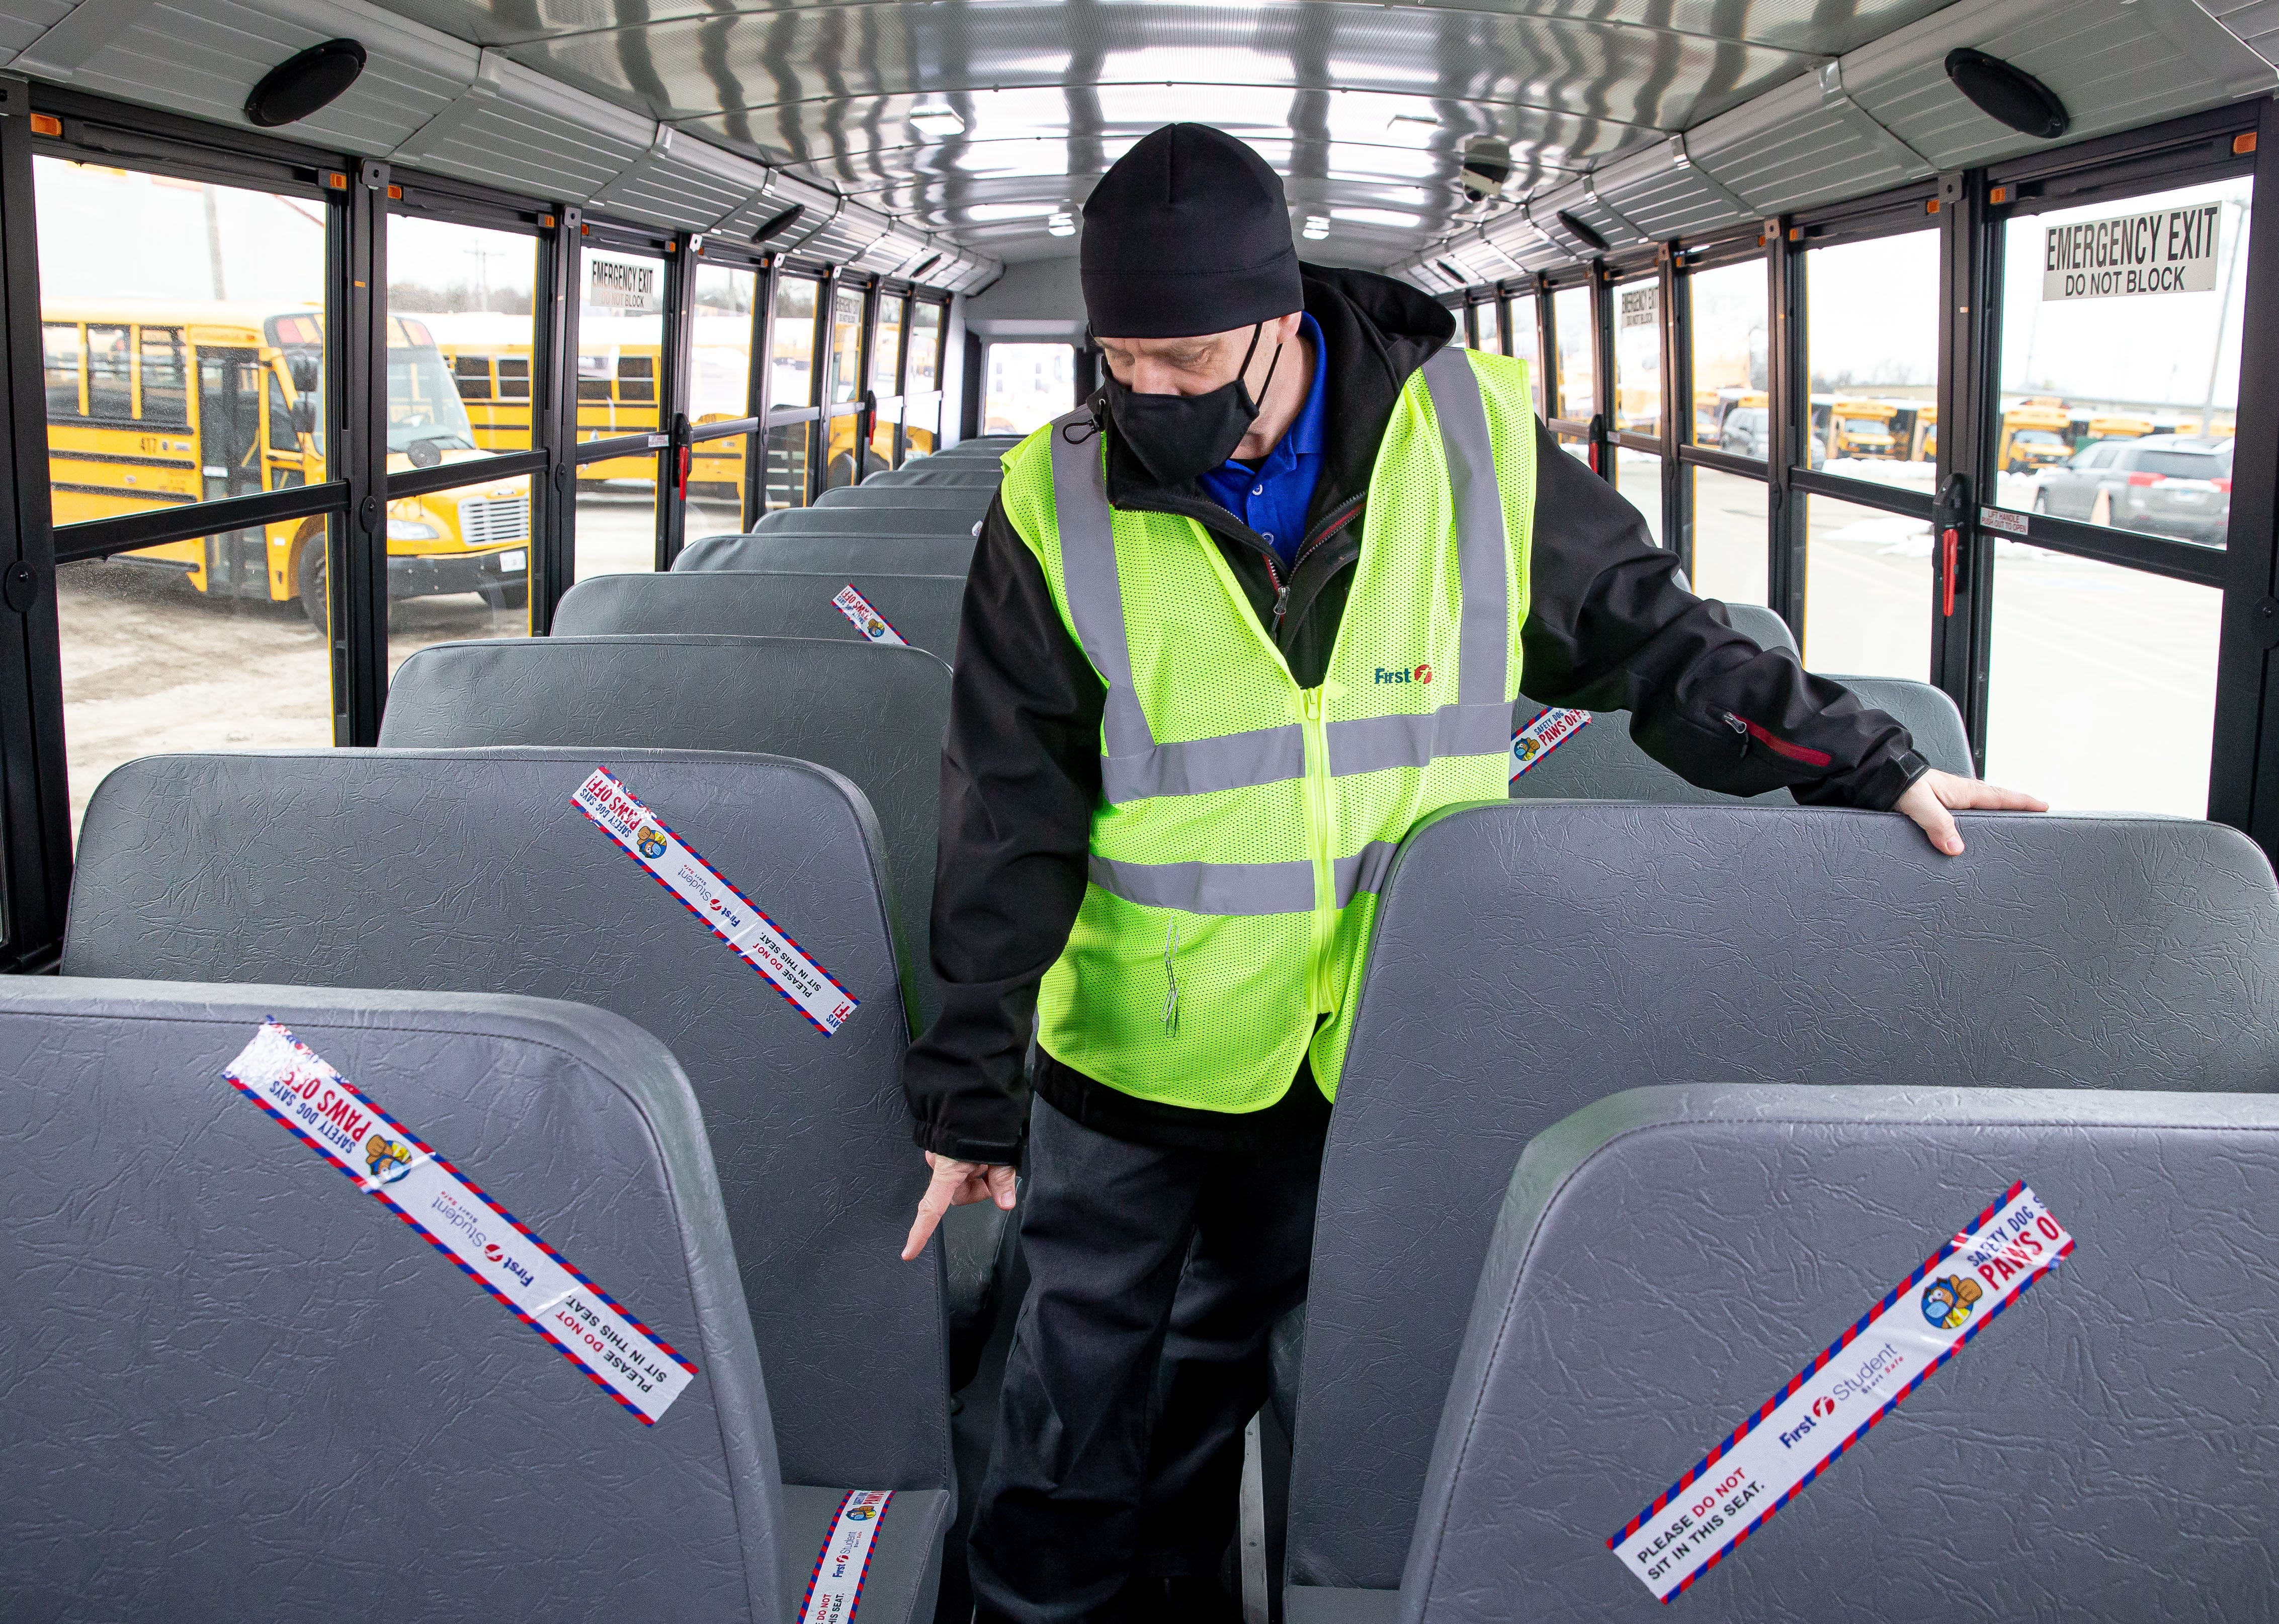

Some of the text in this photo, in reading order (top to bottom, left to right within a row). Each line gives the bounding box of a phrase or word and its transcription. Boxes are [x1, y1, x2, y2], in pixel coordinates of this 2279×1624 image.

[2047, 207, 2218, 271] EMERGENCY EXIT
[593, 261, 653, 293] EMERGENCY EXIT
[601, 291, 644, 308] DO NOT BLOCK
[2065, 266, 2186, 296] DO NOT BLOCK
[1999, 512, 2019, 523] HANDLE
[840, 588, 856, 604] OFF!
[1375, 668, 1411, 684] First
[1534, 710, 1564, 735] SAFETY DOG
[1538, 721, 1567, 747] PAWS
[580, 789, 632, 838] SAFETY DOG SAYS
[585, 776, 642, 831] PAWS OFF!
[678, 868, 741, 927] First Student
[753, 944, 813, 998] PLEASE DO NOT
[759, 932, 822, 992] SIT IN THIS SEAT.
[826, 1014, 841, 1028] AYS
[270, 1081, 356, 1154] SAFETY DOG SAYS
[317, 1090, 372, 1142] PAWS
[431, 1196, 535, 1288] First Student
[1967, 1206, 2034, 1267] SAFETY DOG
[1977, 1231, 2043, 1291] PAWS
[556, 1312, 652, 1394] PLEASE DO NOT
[565, 1295, 668, 1383] SIT IN THIS SEAT.
[1779, 1342, 1898, 1448] First Student
[1637, 1467, 1747, 1563] PLEASE DO NOT
[1648, 1481, 1765, 1580] SIT IN THIS SEAT.
[832, 1531, 857, 1578] First Student
[817, 1610, 826, 1620] DO
[820, 1594, 831, 1608] NOT
[828, 1593, 845, 1624] HIS SEAT.
